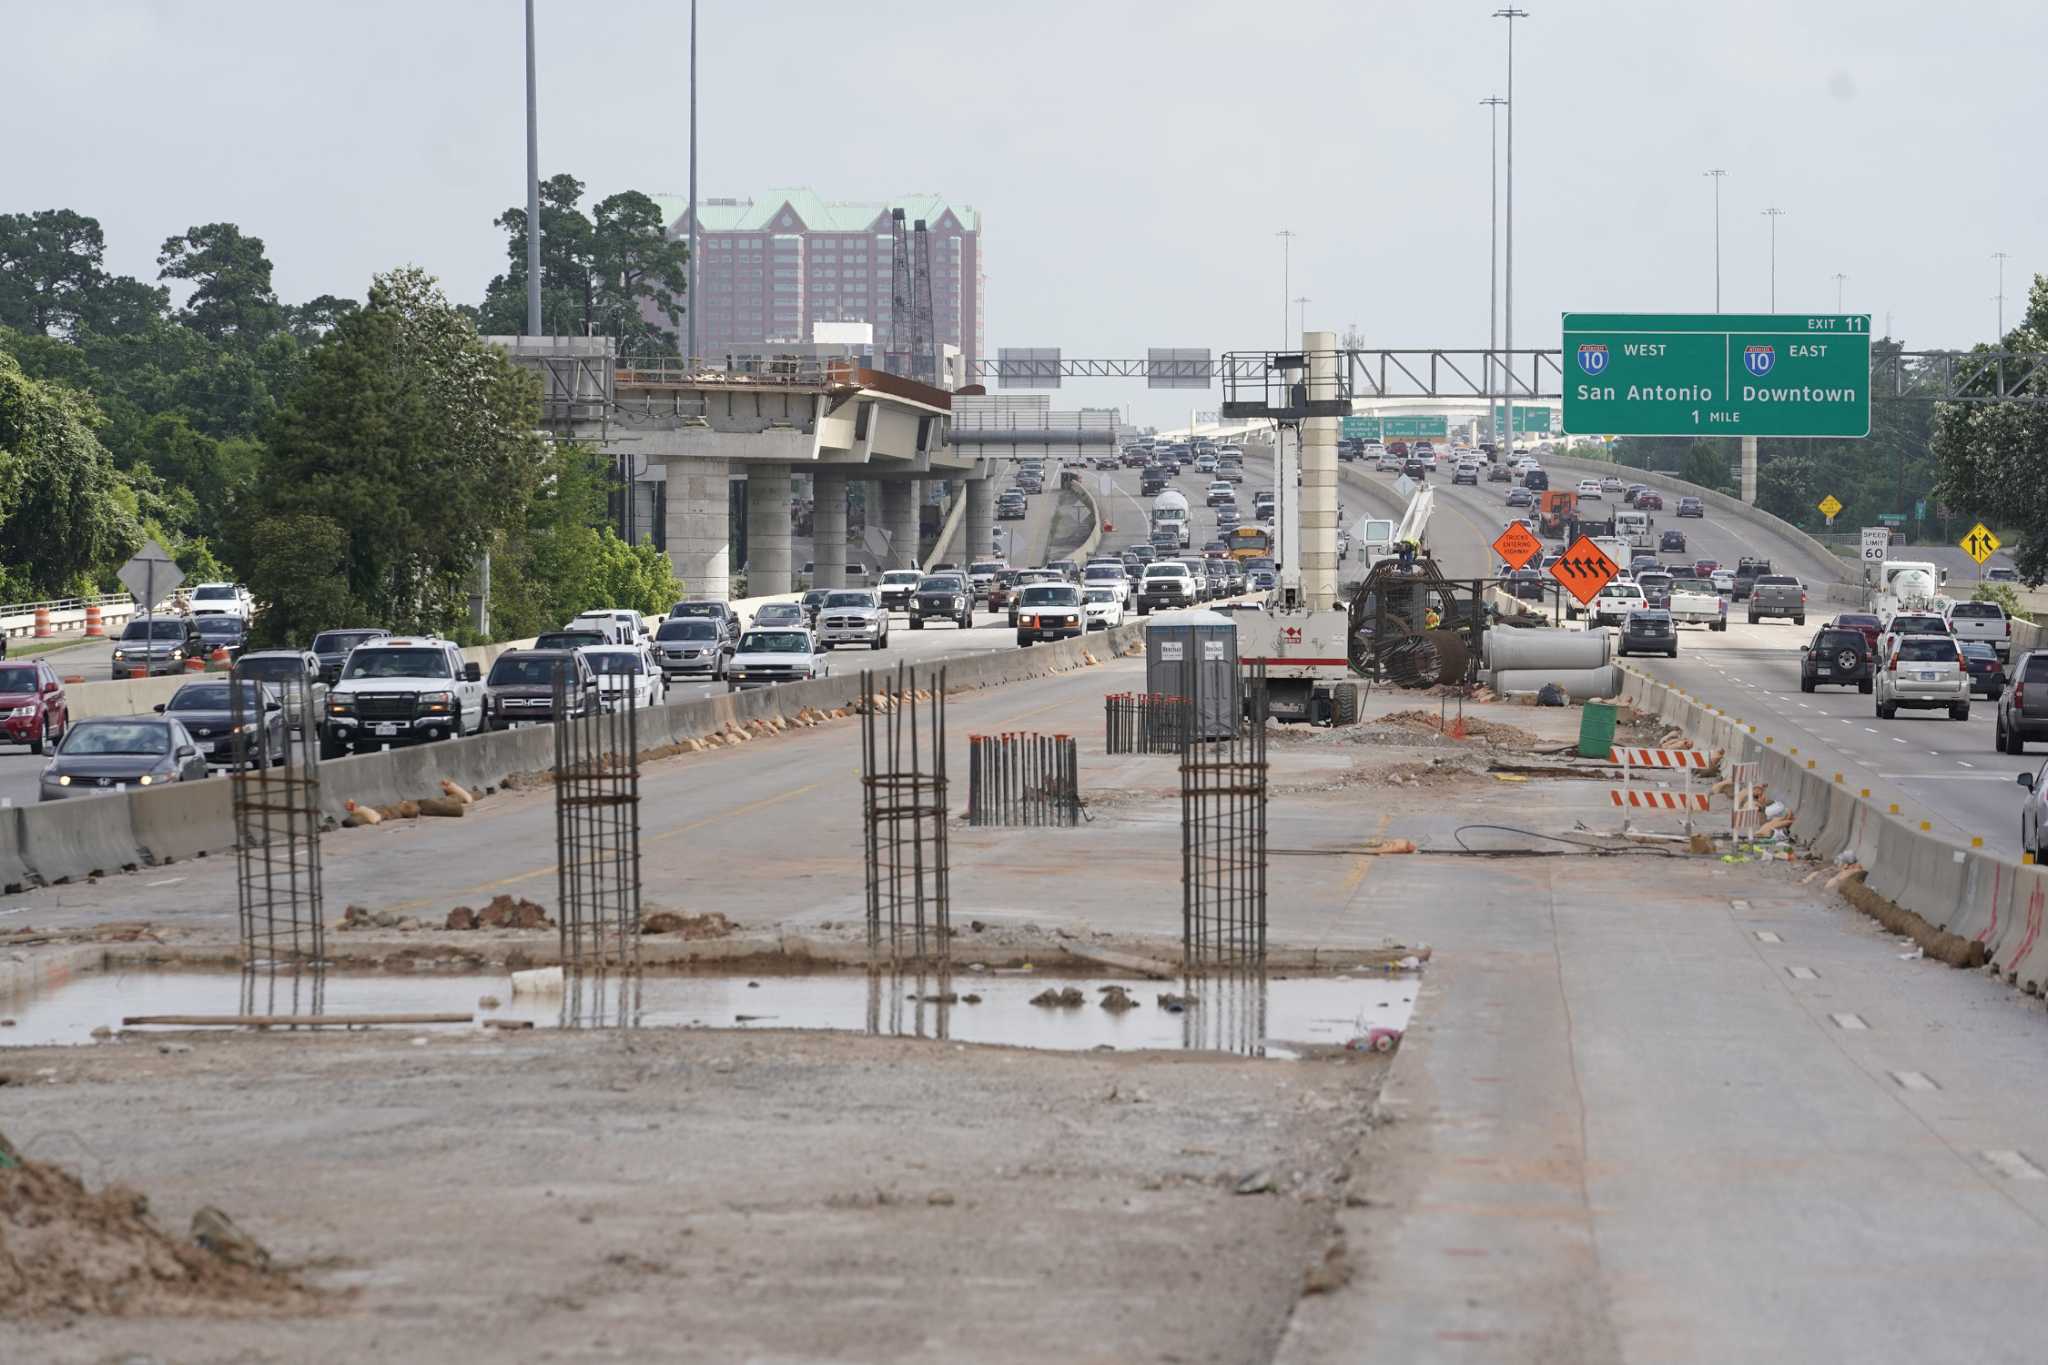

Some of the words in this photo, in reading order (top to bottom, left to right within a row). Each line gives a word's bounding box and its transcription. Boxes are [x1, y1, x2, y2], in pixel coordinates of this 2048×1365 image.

[1807, 318, 1835, 330] EXIT
[1845, 317, 1862, 331] 11
[1624, 344, 1666, 356] WEST
[1790, 345, 1827, 357] EAST
[1584, 352, 1603, 369] 10
[1750, 353, 1769, 370] 10
[1577, 385, 1615, 401] San
[1627, 385, 1712, 401] Antonio
[1743, 386, 1855, 402] Downtown
[1691, 410, 1700, 424] 1
[1710, 412, 1740, 422] MILE
[1865, 548, 1883, 559] 60
